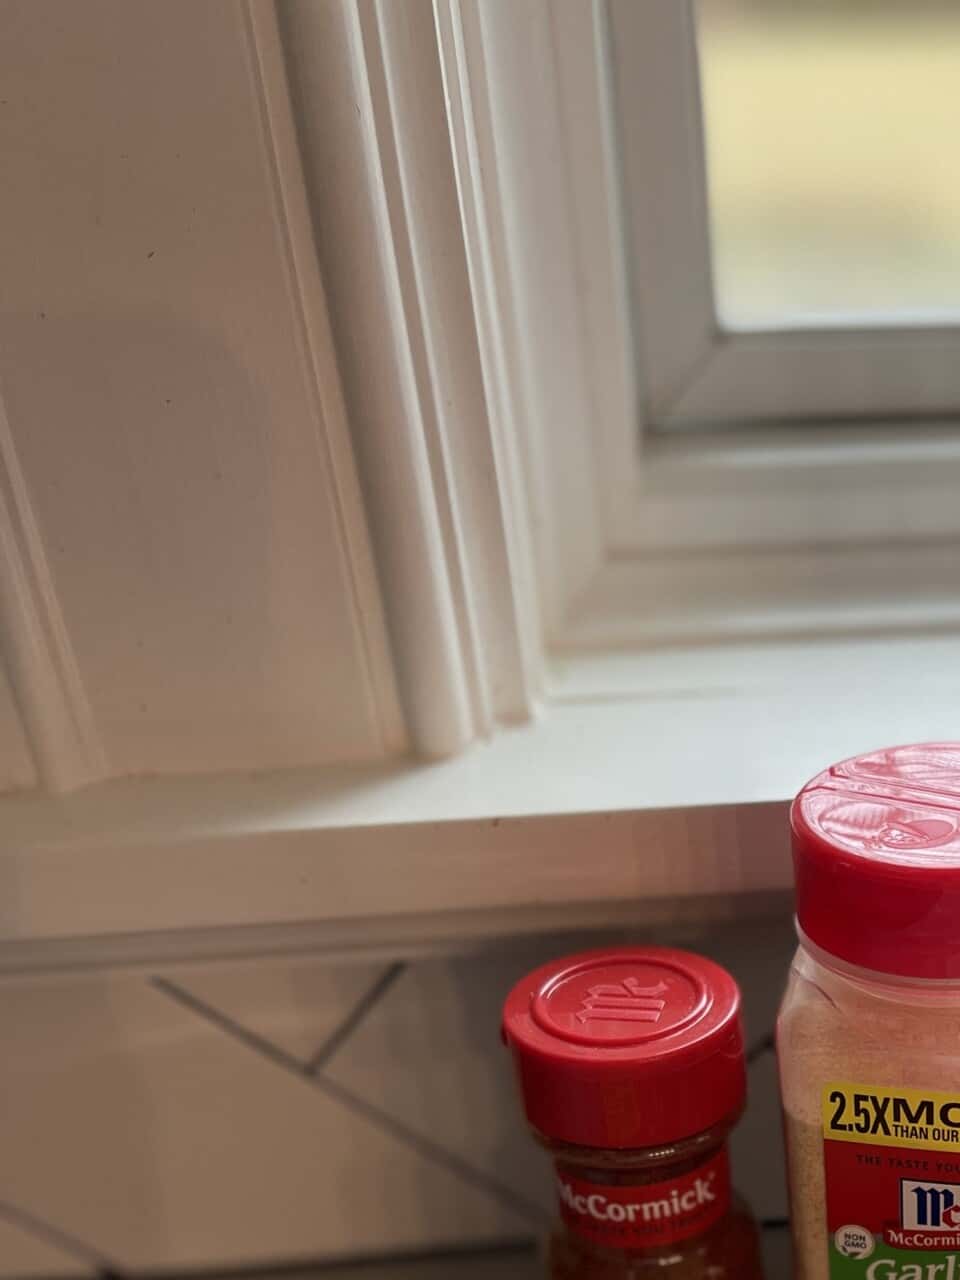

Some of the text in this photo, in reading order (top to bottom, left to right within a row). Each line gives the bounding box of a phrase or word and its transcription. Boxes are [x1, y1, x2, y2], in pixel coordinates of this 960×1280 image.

[829, 1090, 891, 1137] 2.5X
[893, 1123, 929, 1140] THAN
[933, 1127, 958, 1143] OUR
[856, 1154, 881, 1166] THE
[888, 1157, 928, 1170] TASTE
